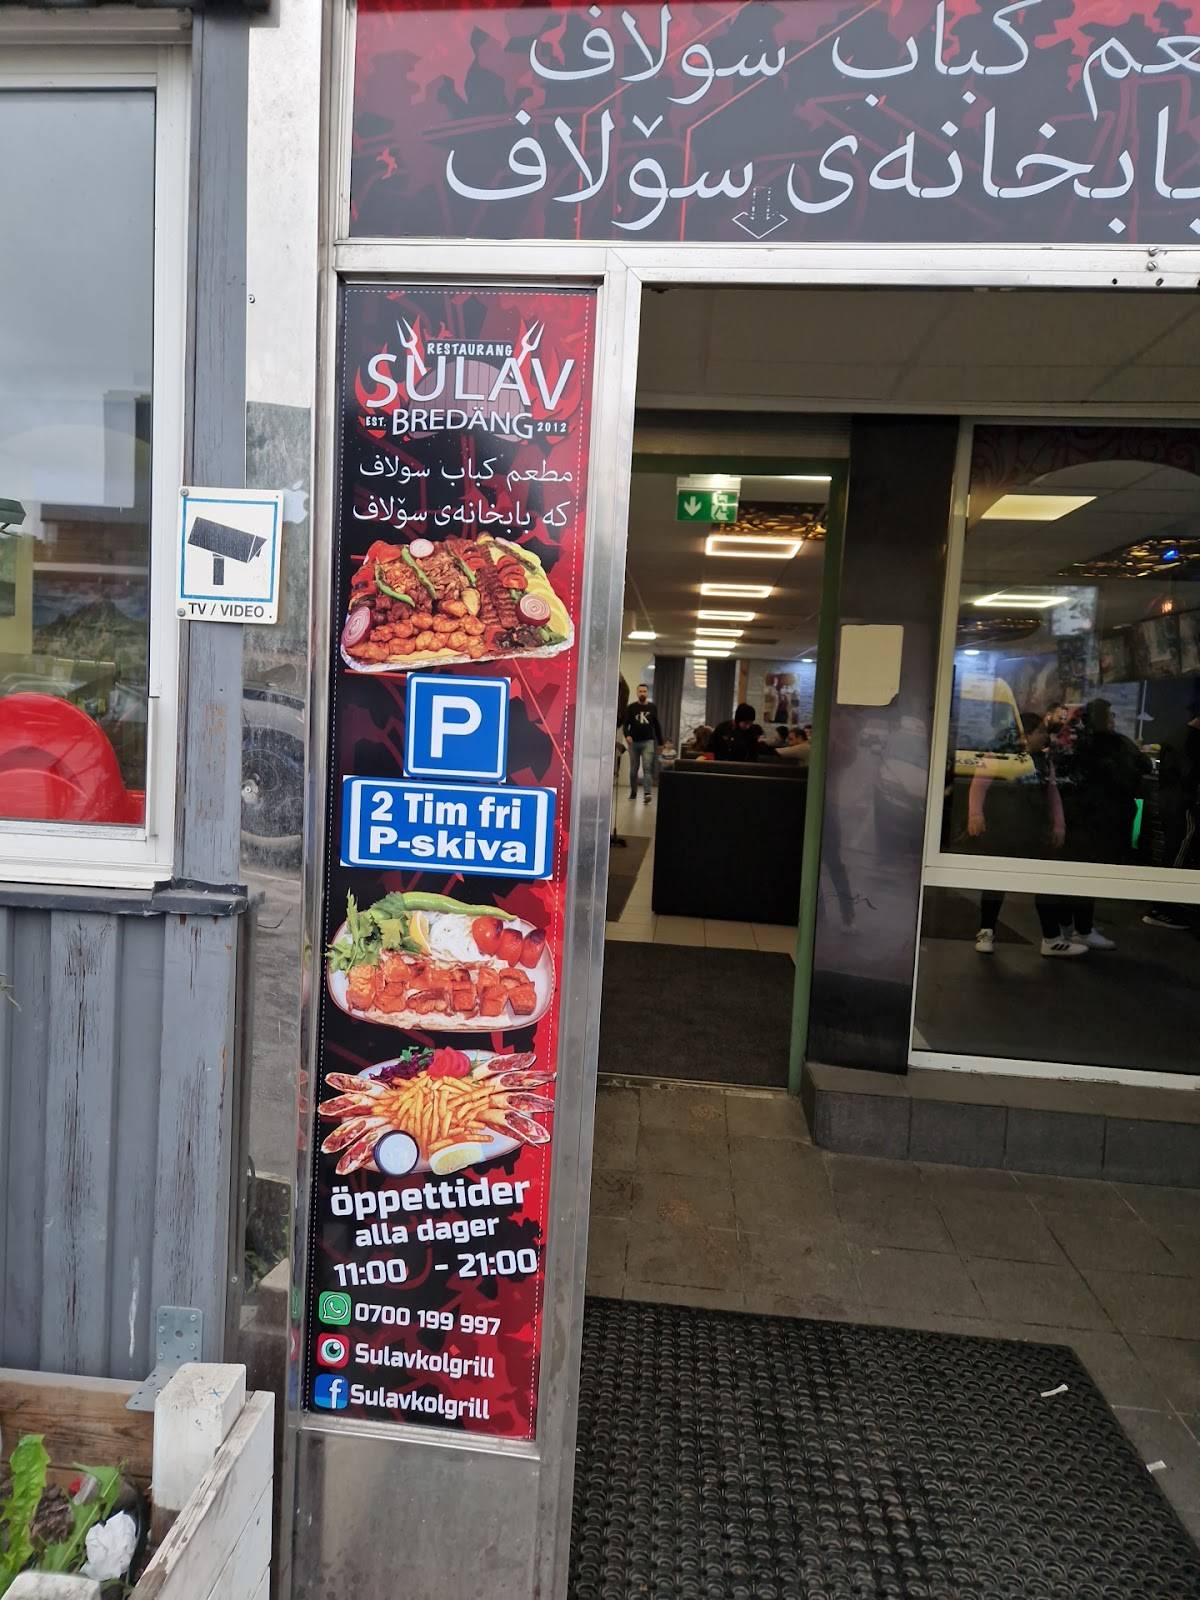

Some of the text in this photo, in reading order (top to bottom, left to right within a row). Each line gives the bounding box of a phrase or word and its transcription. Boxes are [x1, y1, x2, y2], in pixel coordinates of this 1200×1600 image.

[530, 4, 786, 105] سولاف
[427, 342, 513, 357] RESTAURANG
[366, 353, 575, 411] SULAV
[365, 407, 567, 439] EST. BREDÄNG 2012
[359, 455, 430, 485] سولاف
[506, 460, 573, 492] مطعم
[188, 602, 264, 618] TV / VIDEO
[430, 694, 482, 758] P
[371, 791, 521, 830] 2 Tim fri
[369, 826, 527, 863] P-skiva
[331, 1177, 530, 1221] öppettider
[355, 1217, 500, 1247] alla dager
[333, 1258, 408, 1287] 11:00
[457, 1248, 538, 1278] 21:00
[354, 1302, 501, 1336] 0700 199 997
[355, 1343, 495, 1379] Sulavkolgrill
[350, 1384, 490, 1420] Sulavkolgrill
